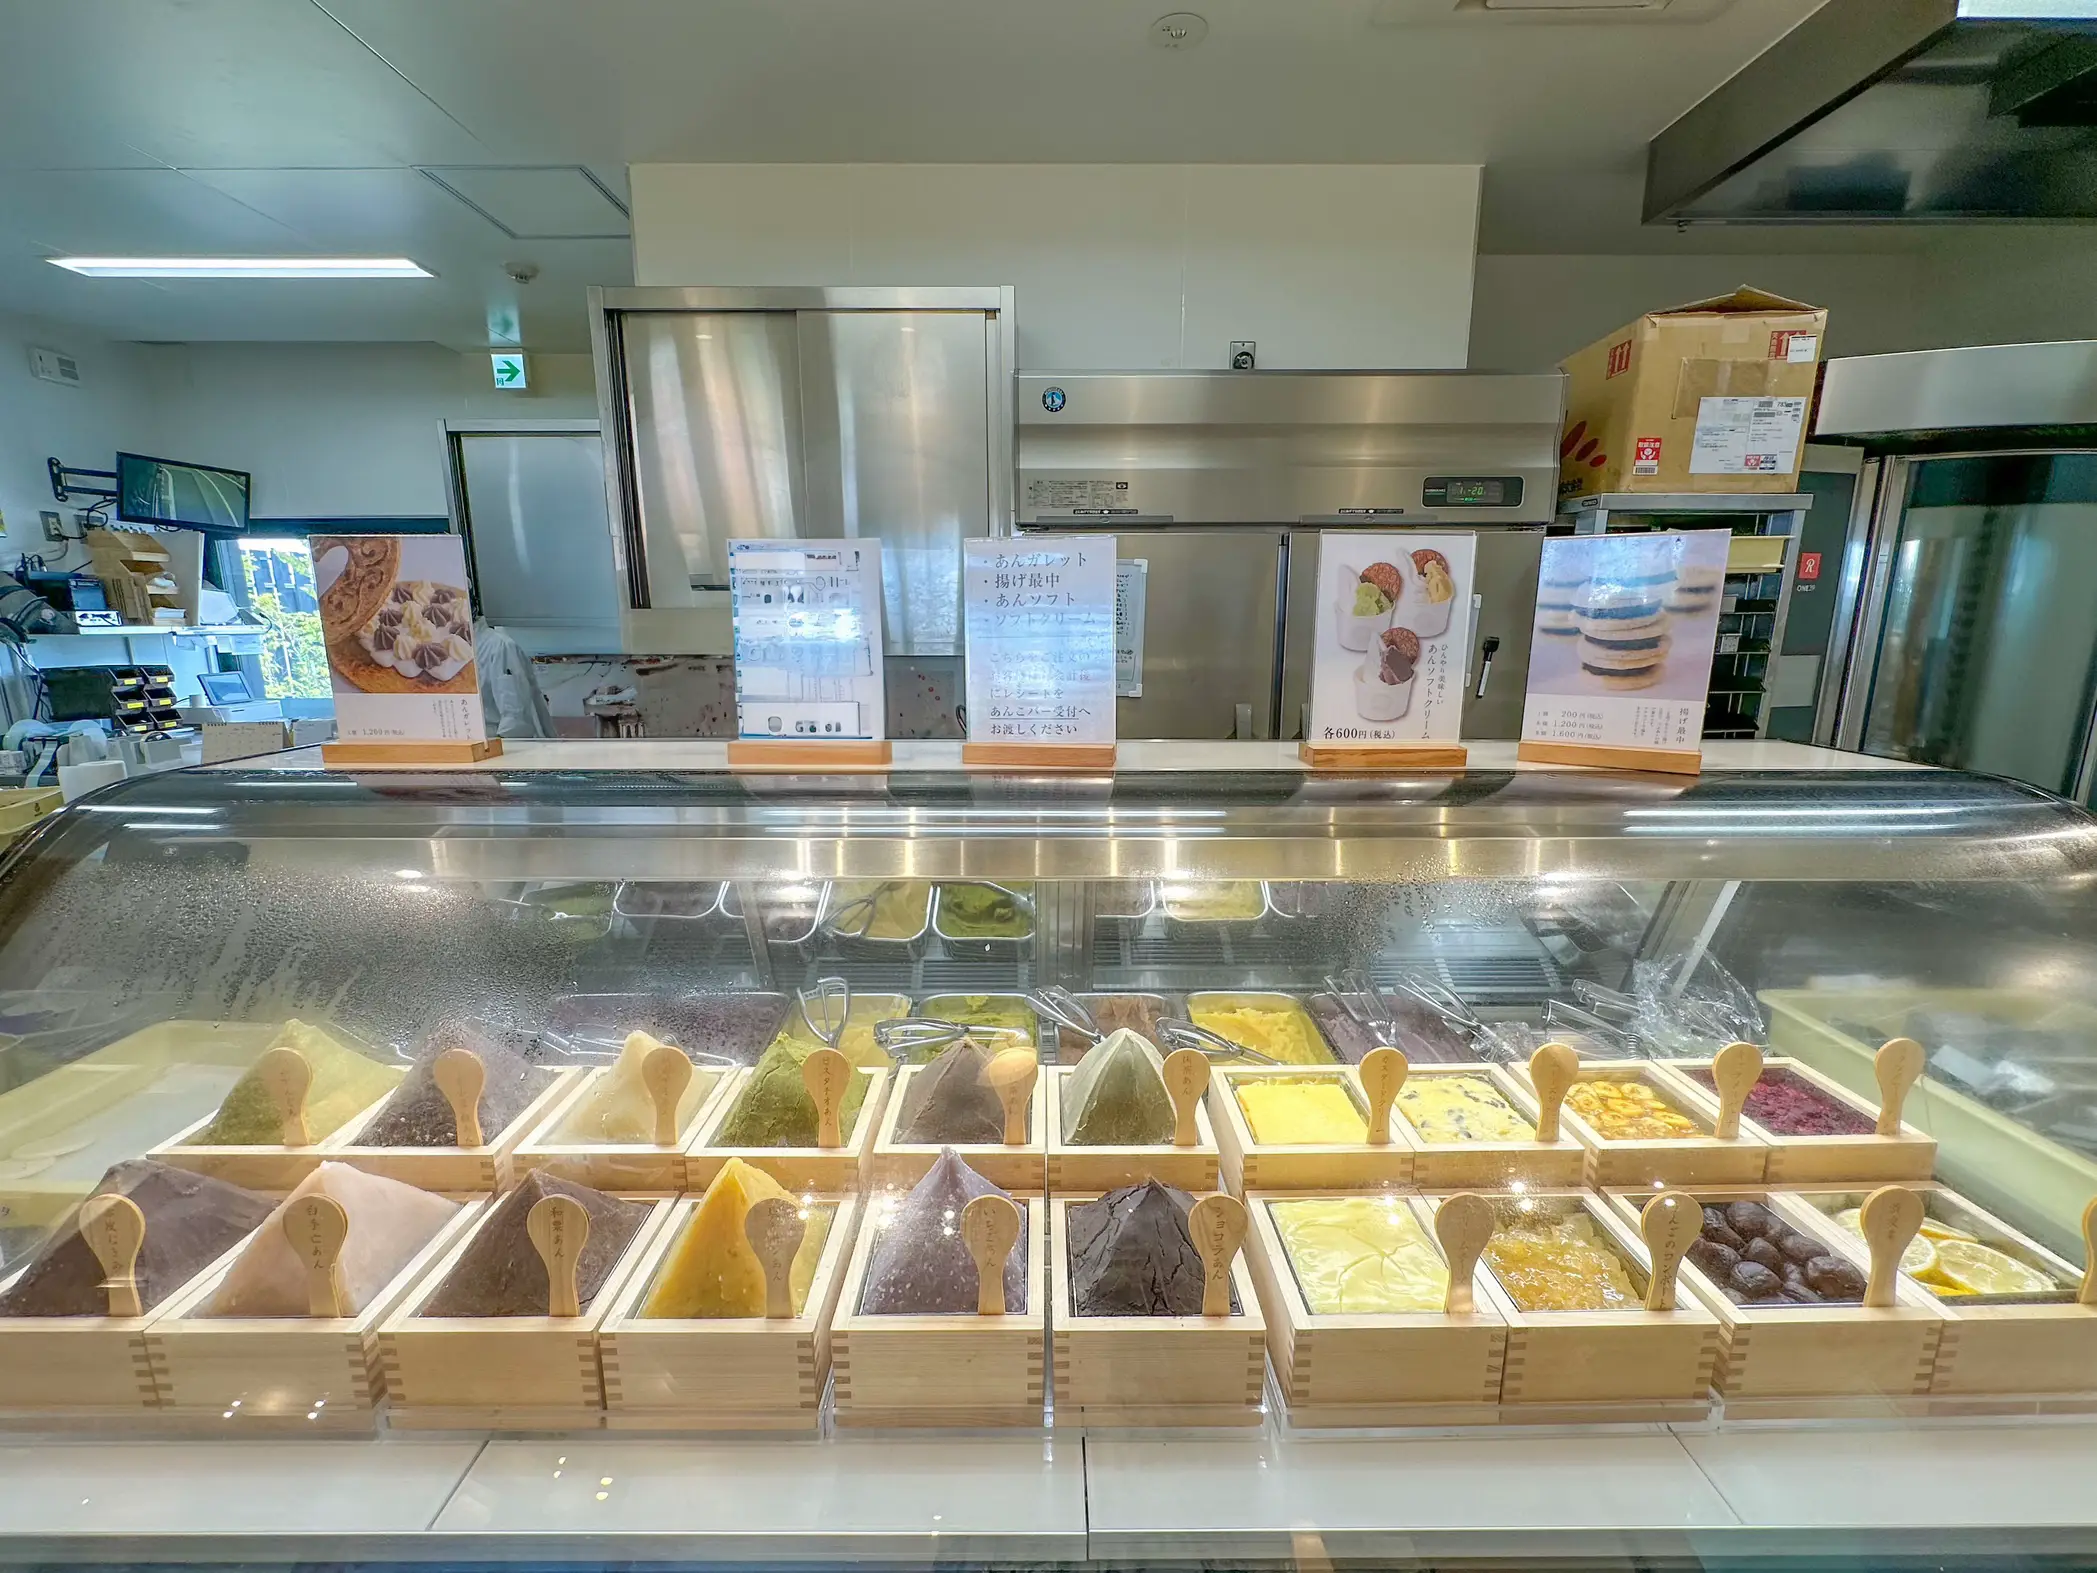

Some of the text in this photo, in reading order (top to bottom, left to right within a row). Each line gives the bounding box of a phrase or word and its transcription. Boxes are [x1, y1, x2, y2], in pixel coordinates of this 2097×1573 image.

[990, 688, 1064, 699] にレシートを
[1421, 644, 1438, 740] あんソフトクリーム
[1436, 644, 1449, 705] ひんやり美味しい
[460, 699, 472, 740] あんガレット
[990, 705, 1091, 718] あんこバー受付へ
[990, 723, 1078, 736] お渡しください
[1675, 707, 1689, 744] 揚げ最中
[822, 1056, 834, 1126] ピスタチオあん
[1375, 1055, 1390, 1133] カスタードクリーム
[549, 1206, 565, 1258] 和栗あん
[1659, 1203, 1680, 1309] んごのコンポート
